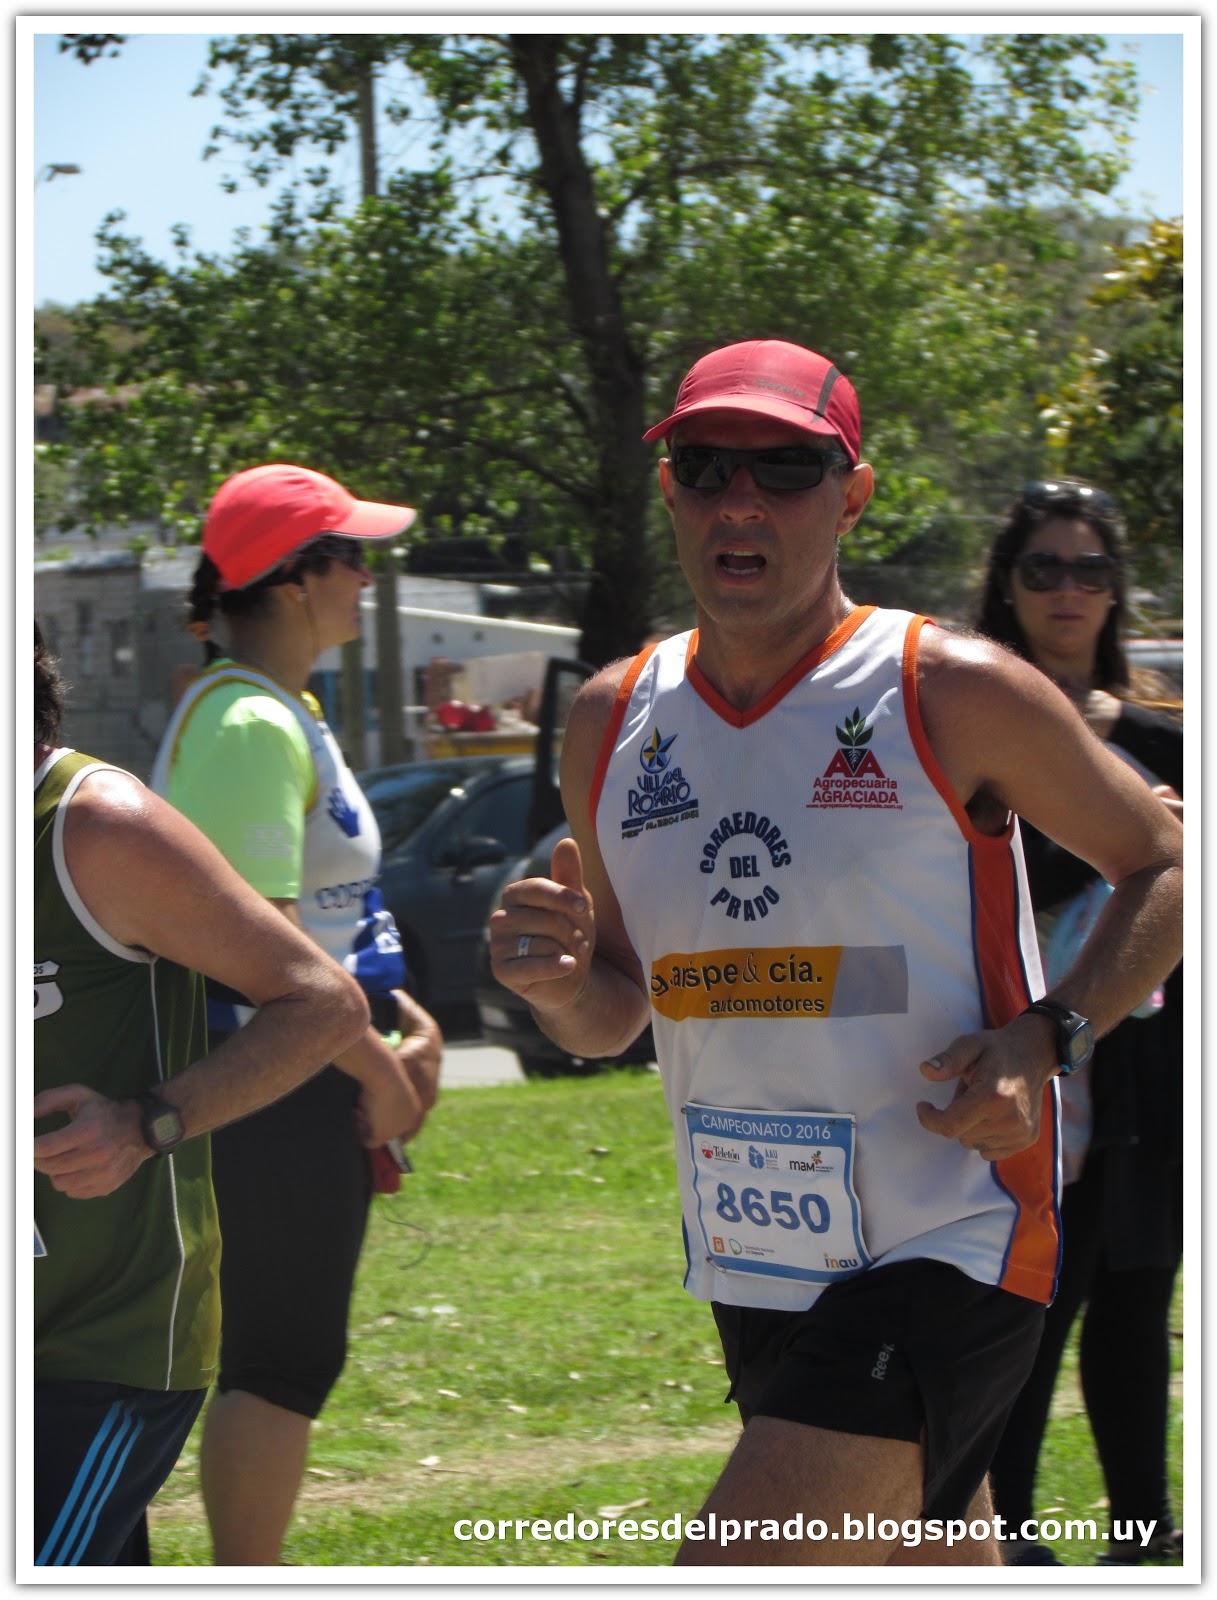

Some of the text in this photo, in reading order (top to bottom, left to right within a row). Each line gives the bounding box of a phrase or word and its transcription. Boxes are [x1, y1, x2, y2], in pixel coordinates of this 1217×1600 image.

[813, 777, 898, 791] Agropecuaria
[812, 790, 899, 804] AGRACIADA
[699, 811, 792, 874] CORREDORES
[729, 855, 760, 879] DEL
[709, 884, 780, 922] PRADO
[651, 952, 823, 997] g.arspe & cía.
[701, 1114, 831, 1140] CAMPEONATO 2016
[712, 1145, 741, 1161] Teletón
[716, 1182, 831, 1234] 8650
[823, 1250, 859, 1269] inau
